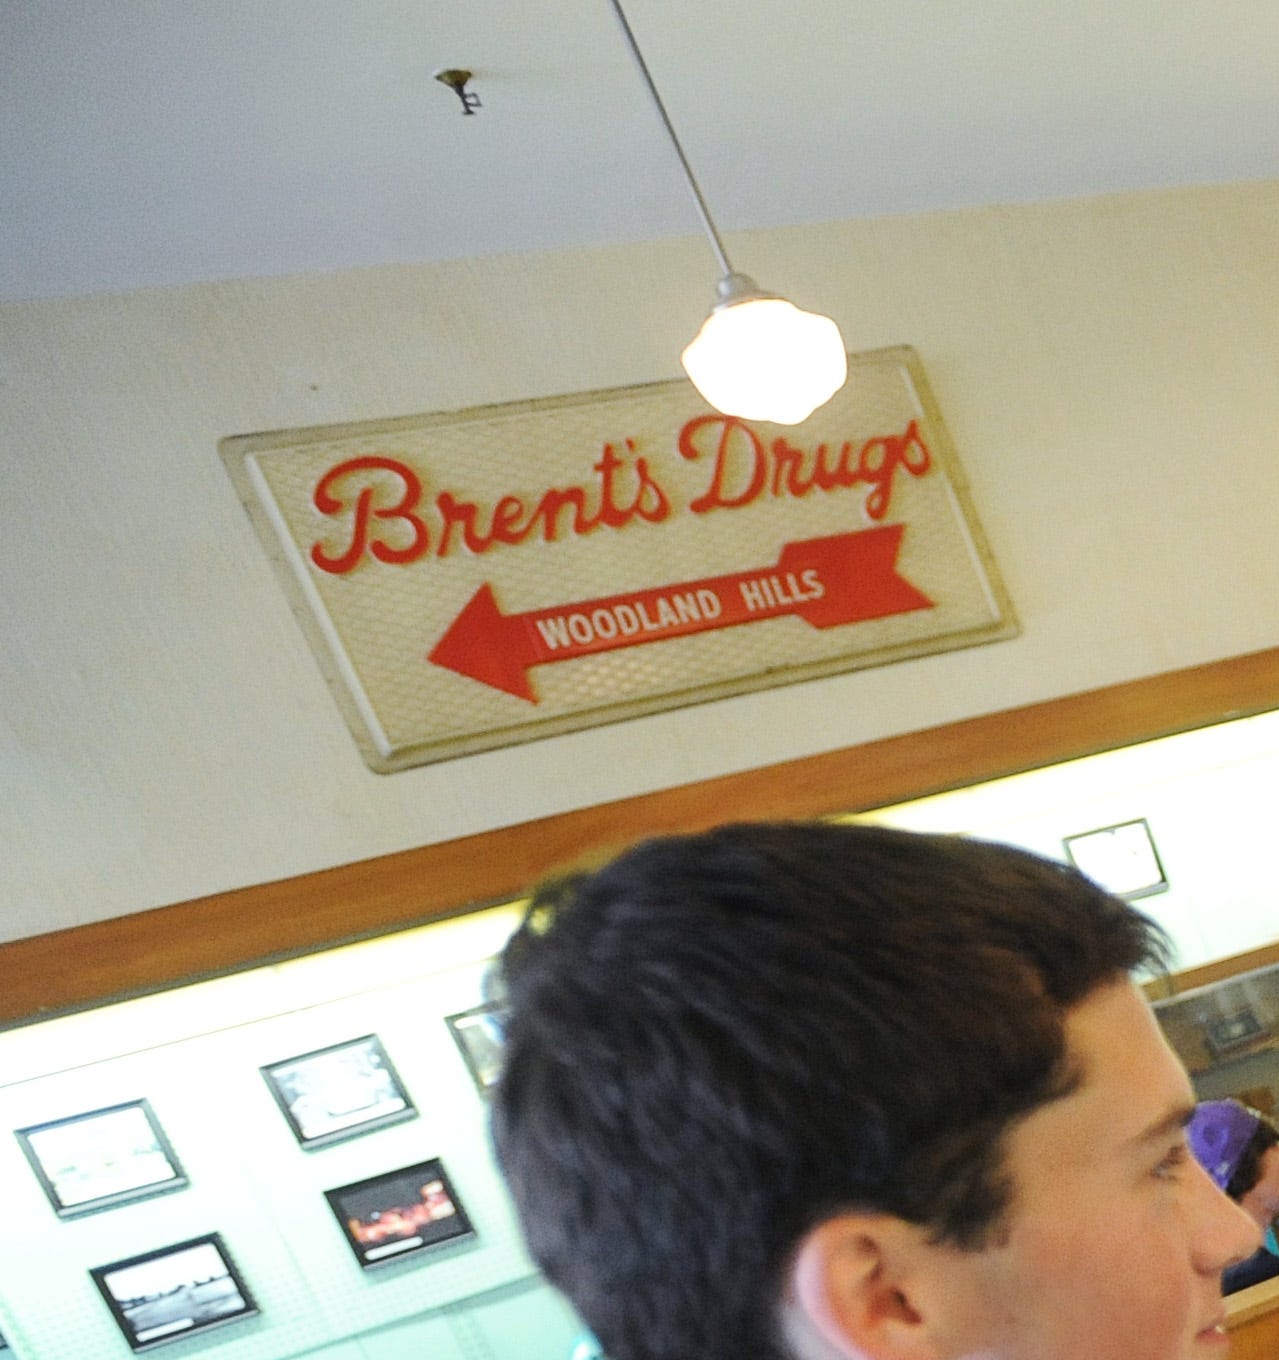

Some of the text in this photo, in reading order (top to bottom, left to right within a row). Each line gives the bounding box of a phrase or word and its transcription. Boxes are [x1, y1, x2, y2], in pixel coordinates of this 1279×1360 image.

[311, 414, 931, 574] Brent's Drugs
[536, 569, 825, 651] WOODLAND HILLS
